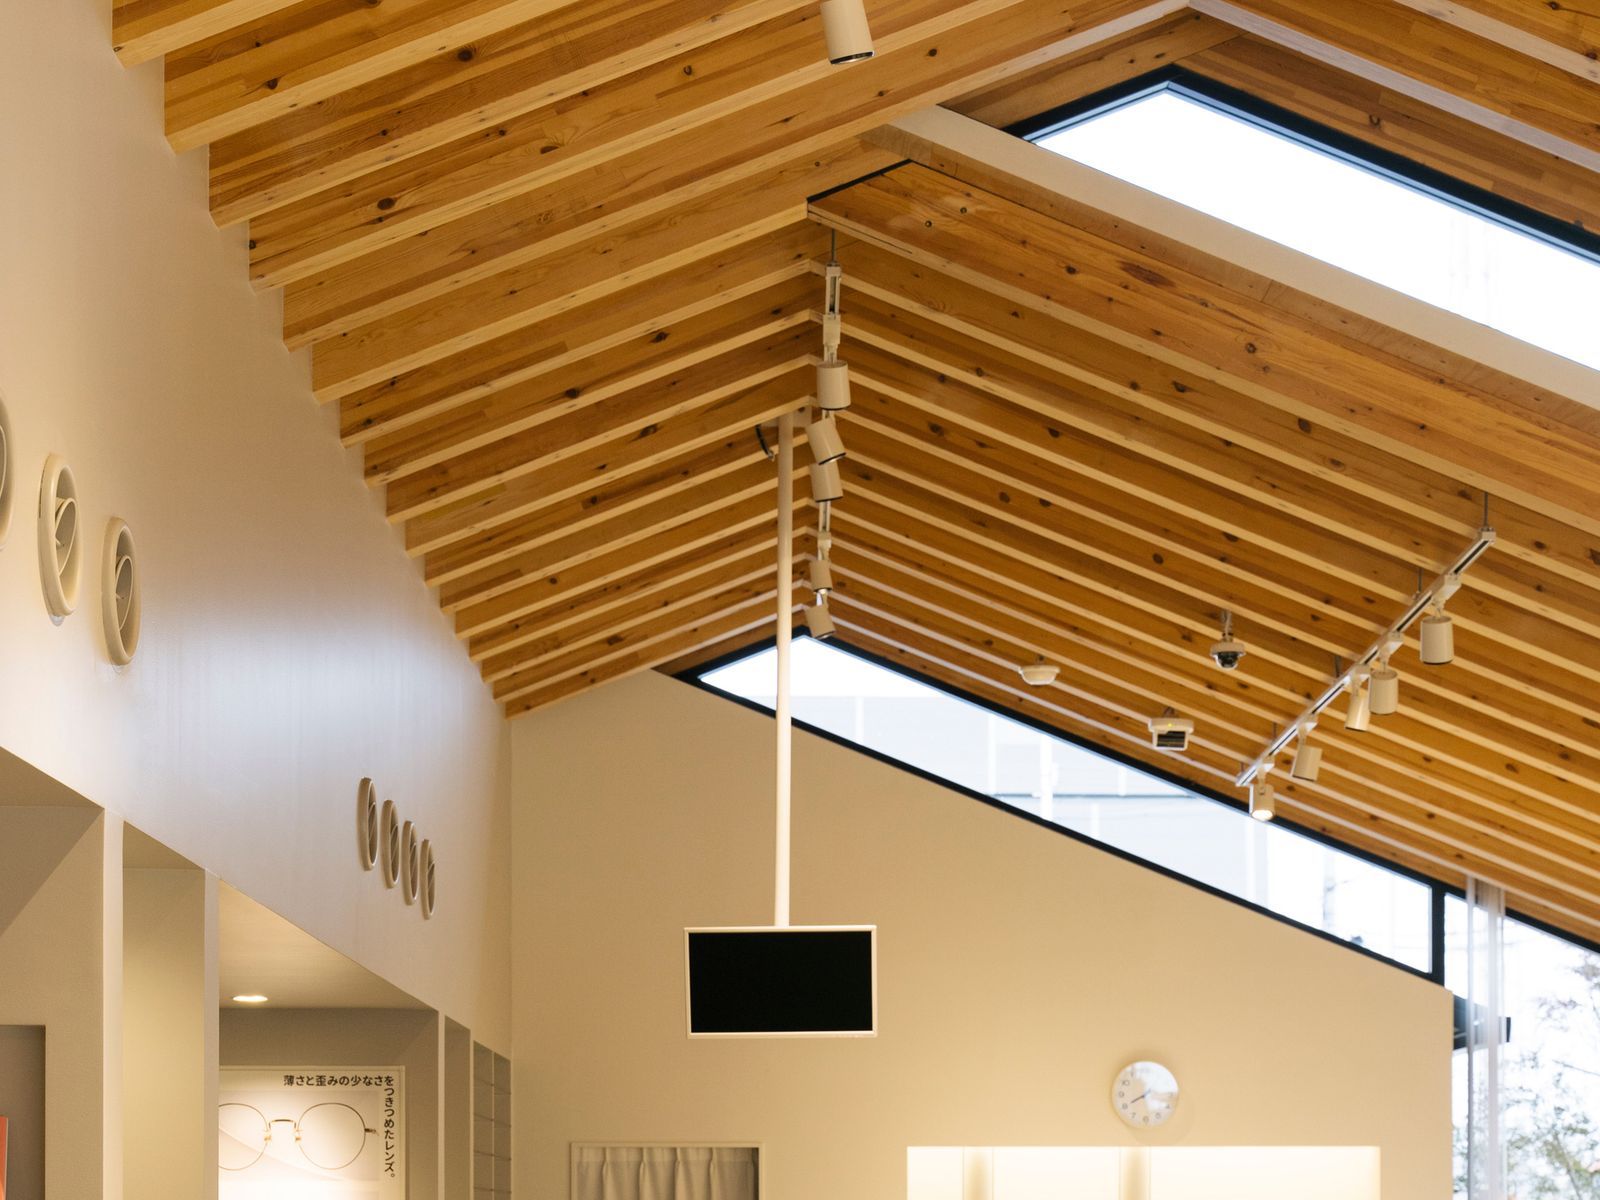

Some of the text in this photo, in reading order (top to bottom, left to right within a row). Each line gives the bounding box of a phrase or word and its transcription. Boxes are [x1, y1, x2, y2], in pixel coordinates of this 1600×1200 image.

[283, 1074, 395, 1087] 薄さと歪みの少なさを
[383, 1087, 396, 1178] つきつめたレンズ。
